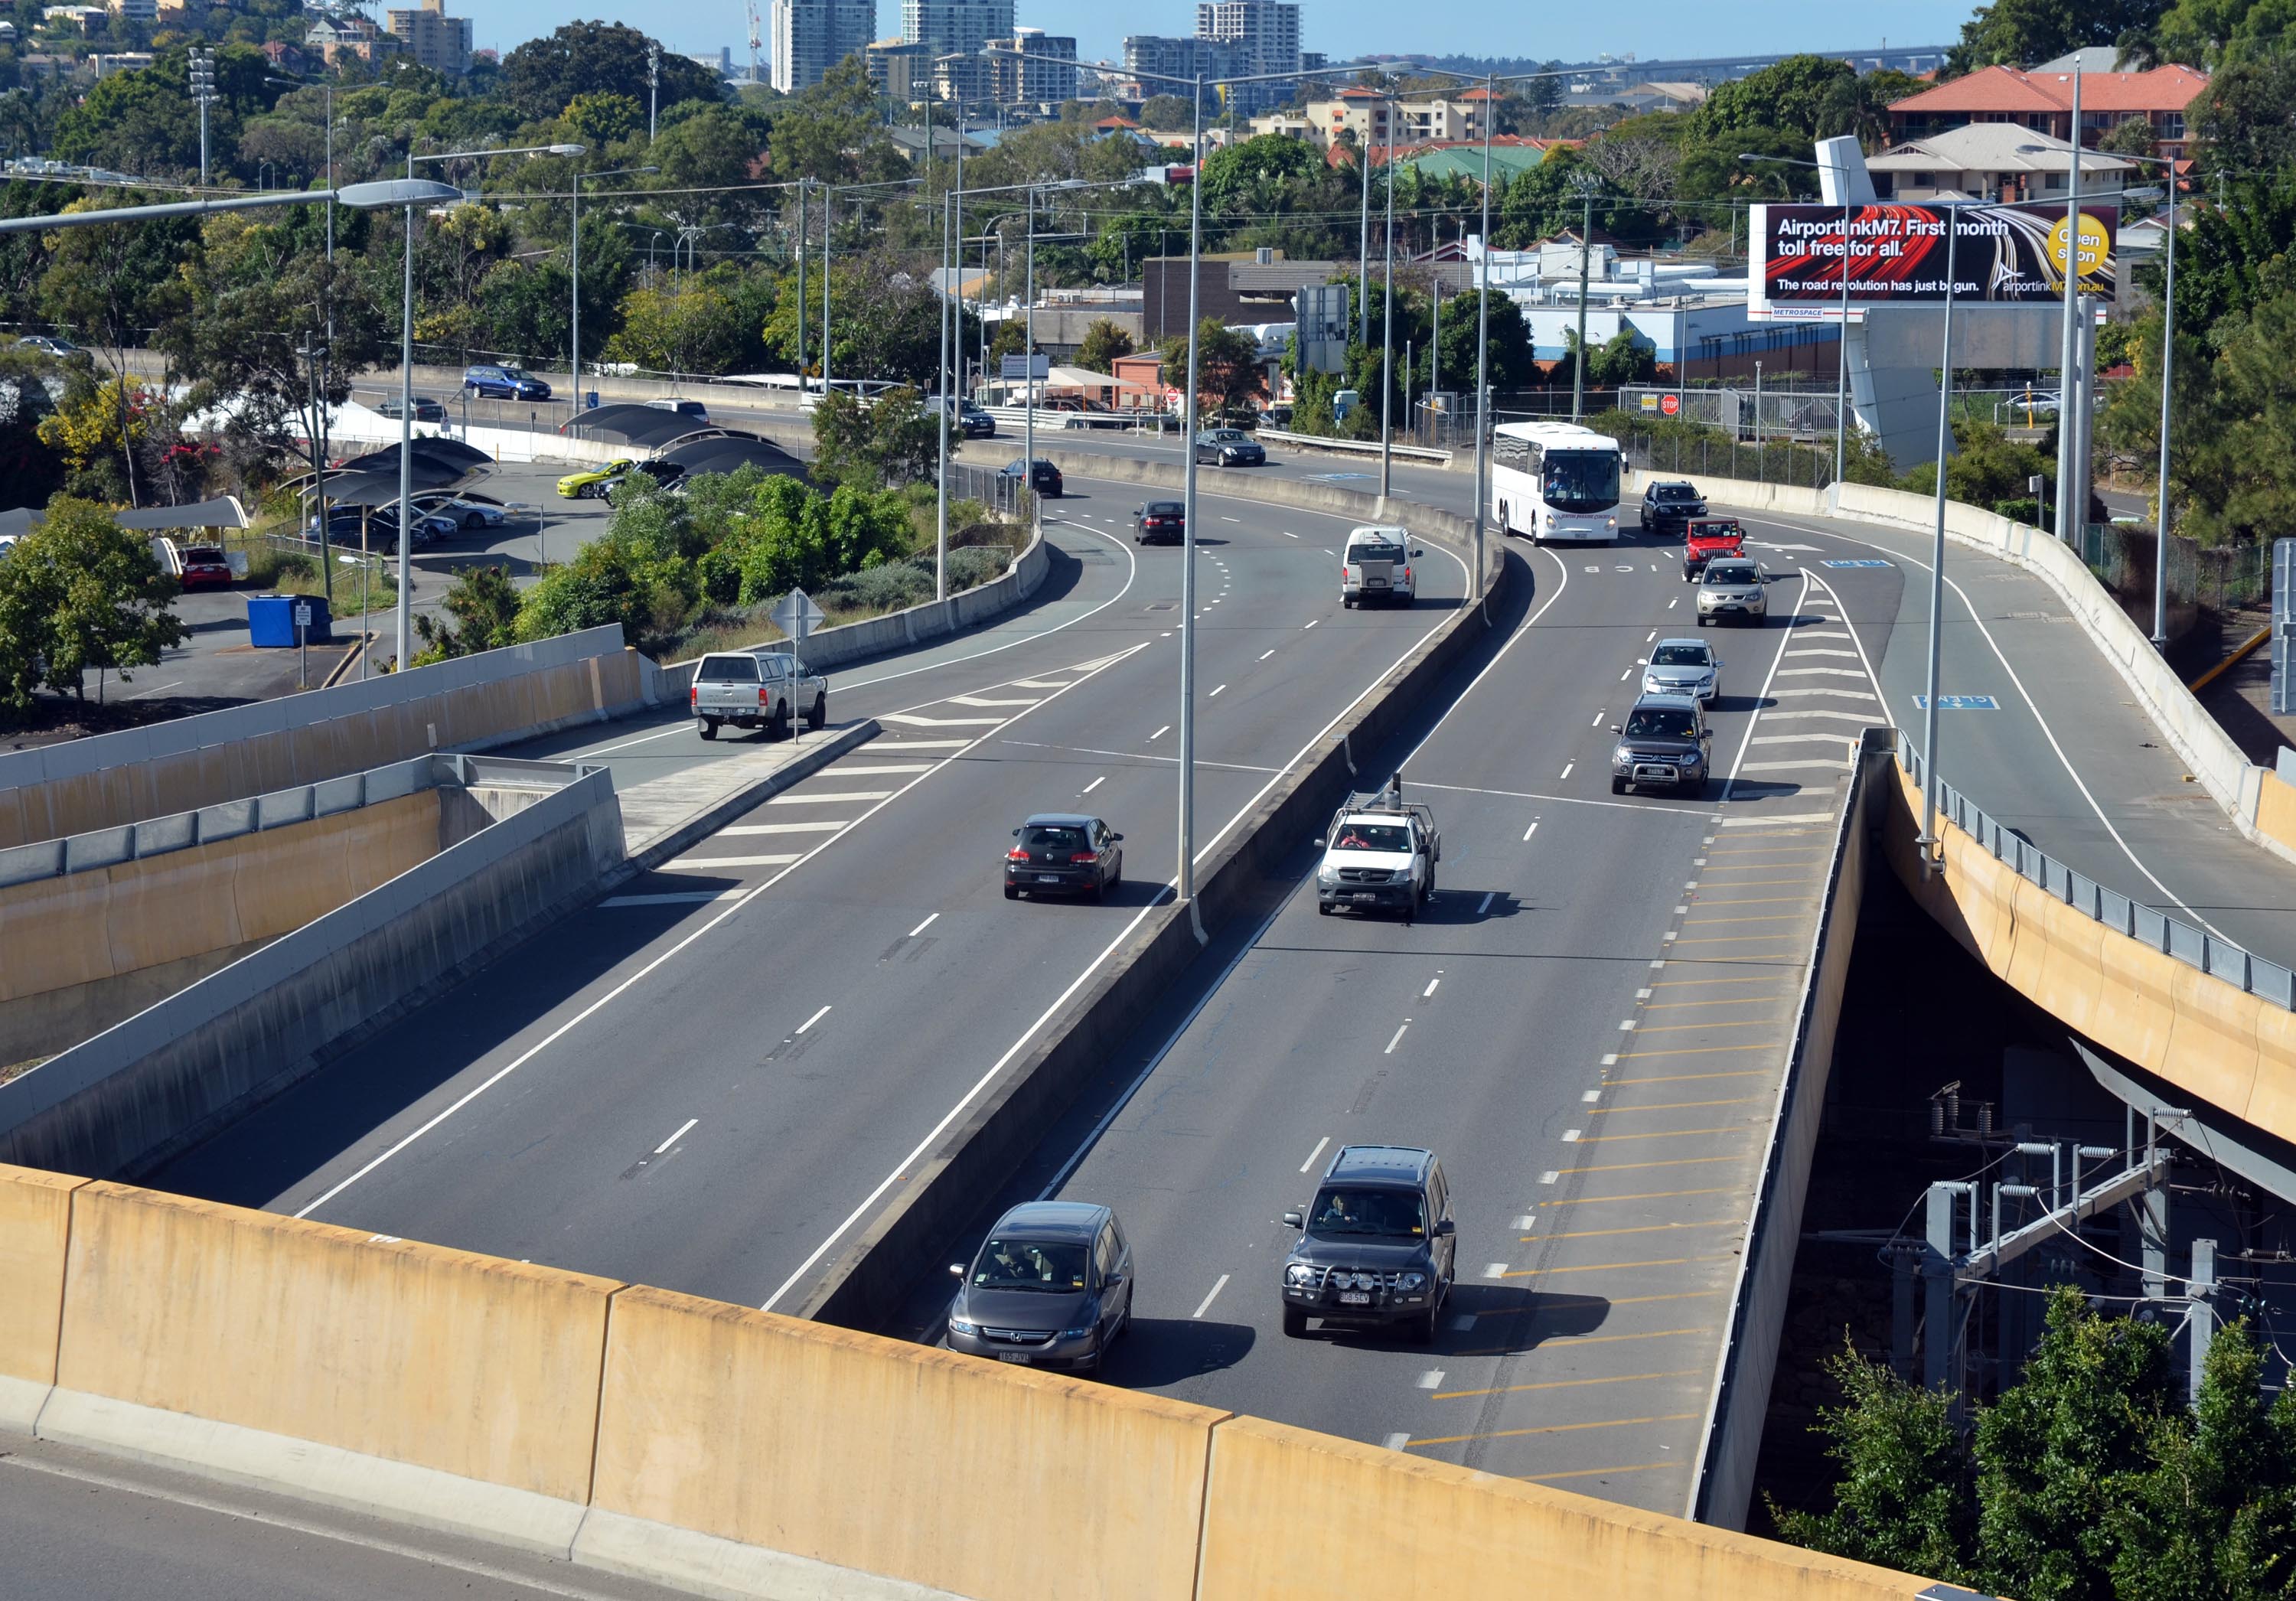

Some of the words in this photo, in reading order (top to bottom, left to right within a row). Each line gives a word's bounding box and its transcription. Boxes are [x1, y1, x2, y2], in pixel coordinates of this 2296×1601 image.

[1778, 219, 1902, 238] AirportlnkM7.
[1906, 219, 1945, 236] First
[2059, 229, 2100, 246] Oen
[1778, 240, 1805, 256] toll
[1809, 240, 1844, 256] free
[1849, 240, 1874, 256] for
[1879, 240, 1903, 256] all.
[2057, 248, 2095, 262] son
[1777, 279, 1799, 290] The
[1802, 279, 1828, 290] road
[1891, 280, 1912, 291] has
[1914, 280, 1937, 293] just
[1939, 280, 1979, 293] bgun.
